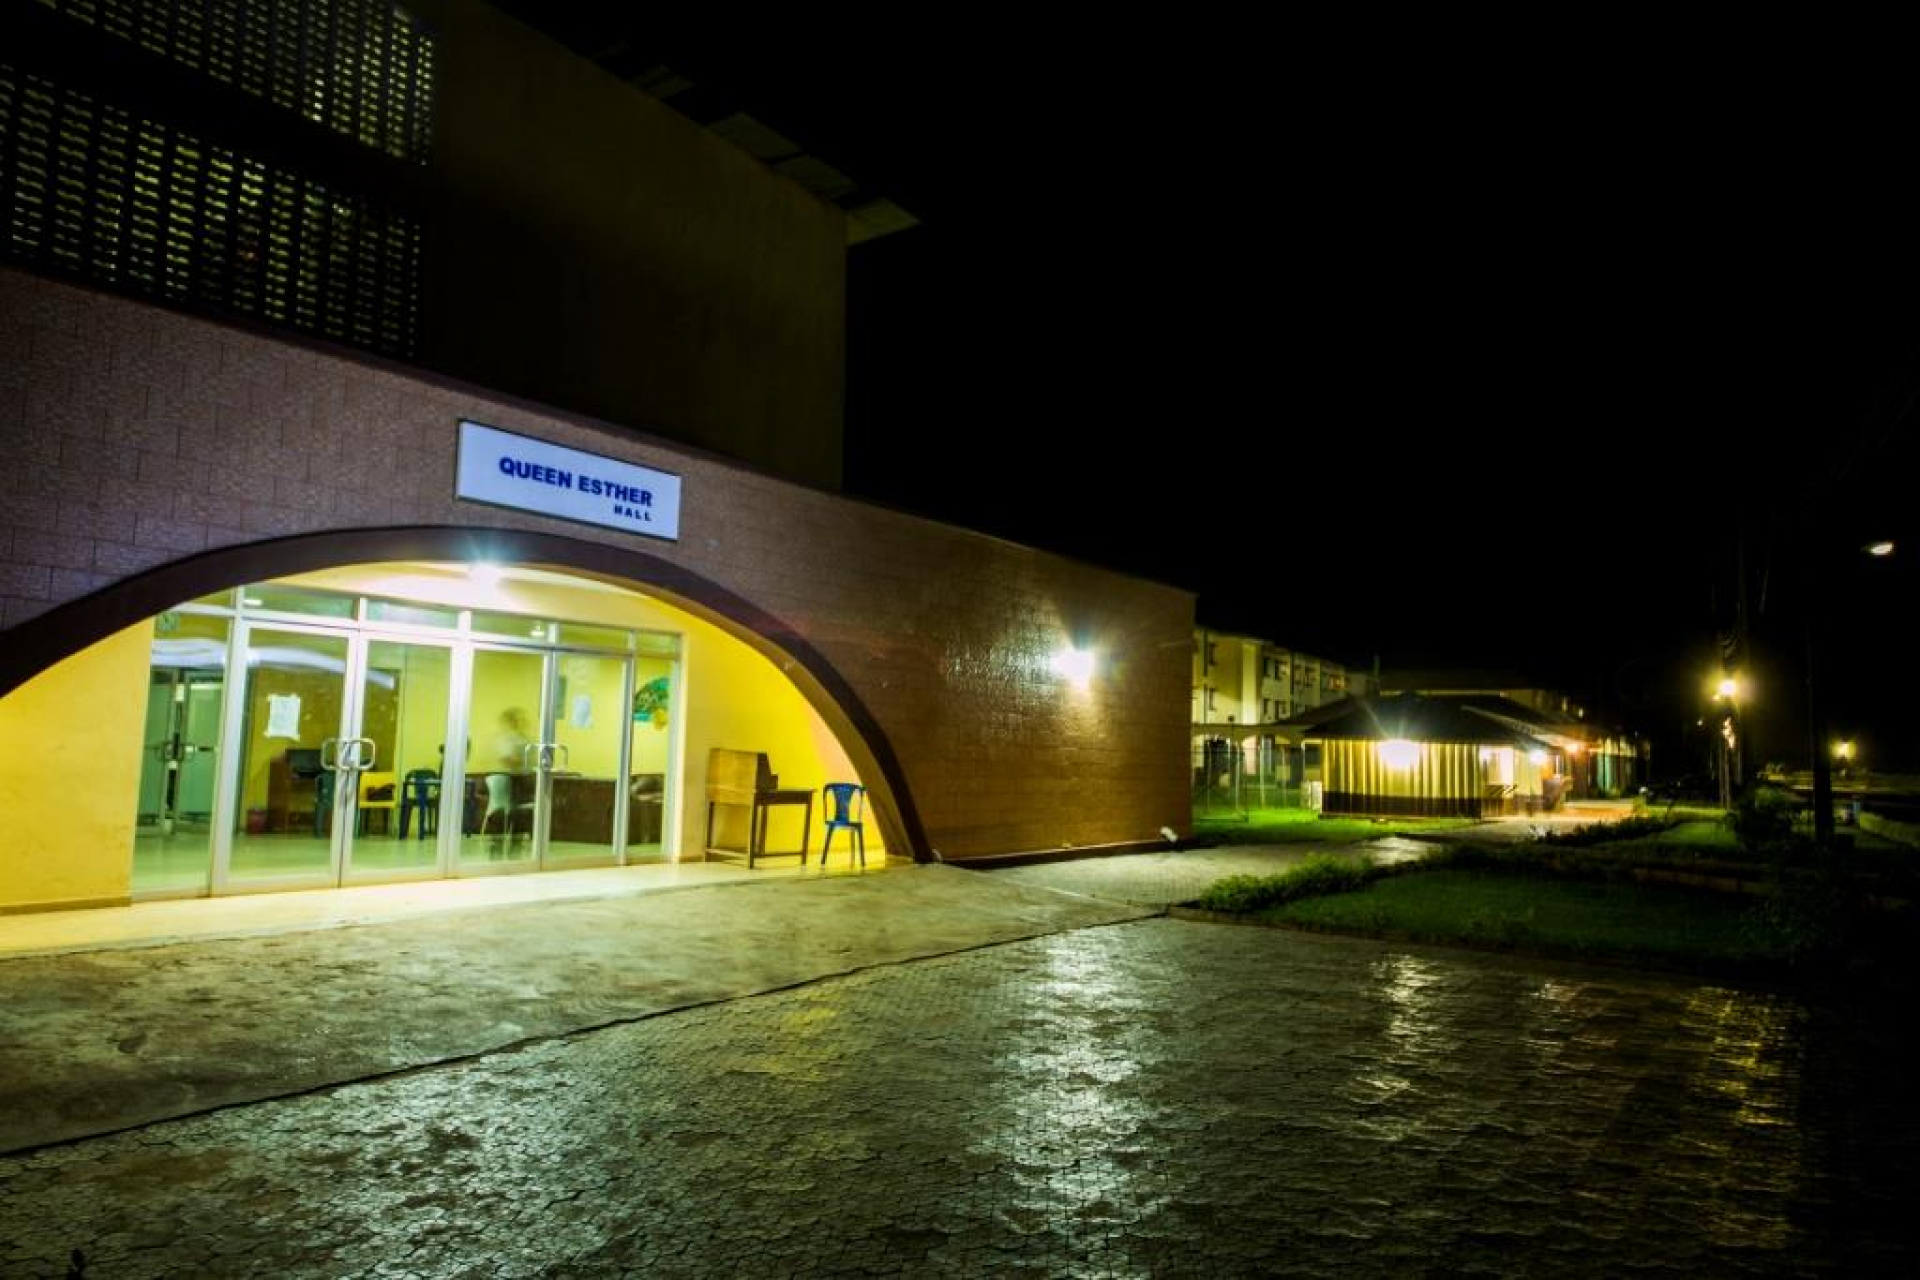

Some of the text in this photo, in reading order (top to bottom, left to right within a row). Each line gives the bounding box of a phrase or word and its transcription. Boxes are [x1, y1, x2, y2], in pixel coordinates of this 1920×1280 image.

[499, 456, 653, 506] QUEEN ESTHER
[614, 504, 652, 521] HALL
